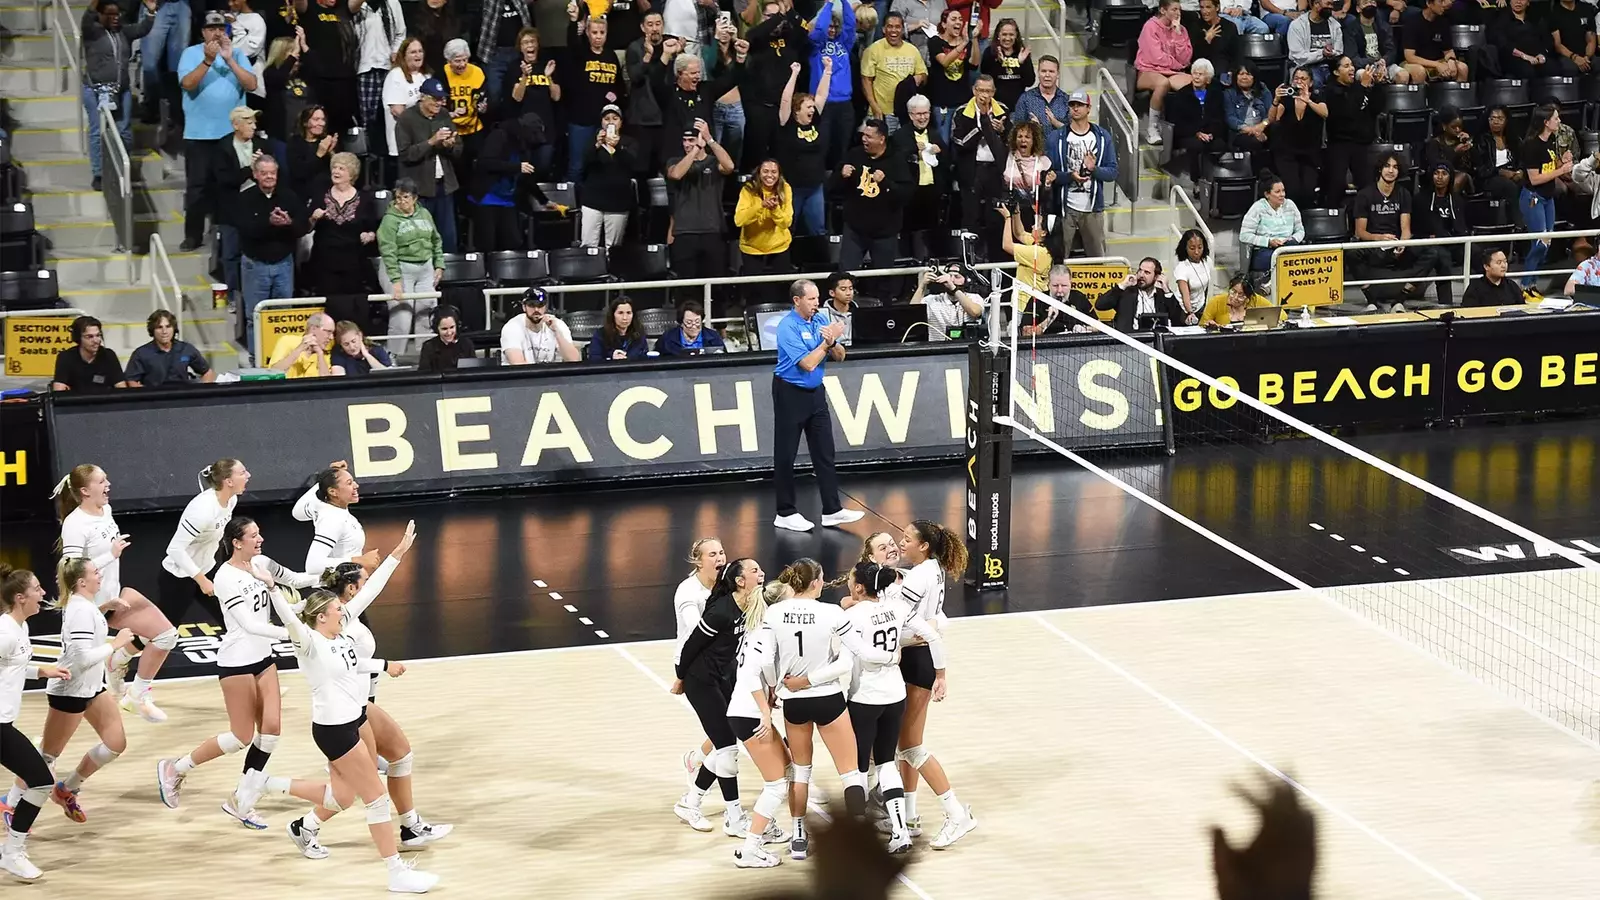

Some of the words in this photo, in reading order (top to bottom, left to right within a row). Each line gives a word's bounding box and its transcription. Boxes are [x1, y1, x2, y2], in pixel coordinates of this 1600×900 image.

[1371, 203, 1400, 212] BEACH
[1283, 258, 1321, 268] SECTION
[1323, 255, 1338, 263] 104
[1072, 271, 1106, 279] ECTION
[1108, 271, 1123, 279] 103
[1288, 268, 1315, 277] ROWS
[1317, 266, 1333, 274] A-U
[1292, 279, 1316, 287] Seats
[1318, 276, 1329, 284] 1-7
[13, 324, 60, 332] SECTION
[63, 324, 73, 332] 10
[267, 314, 311, 324] SECTION
[274, 325, 305, 334] ROWS
[1457, 357, 1523, 393] GO
[1540, 352, 1599, 388] BE
[1174, 375, 1241, 412] GO
[1257, 363, 1431, 406] BEACH
[347, 380, 760, 478] BEACH
[822, 356, 1163, 446] WINS!
[967, 399, 979, 540] BEACH
[991, 492, 999, 518] sports
[990, 518, 999, 551] imports
[984, 553, 1004, 579] LB
[253, 590, 268, 612] 20
[783, 612, 816, 625] MEYER
[870, 610, 897, 626] GLENN
[794, 630, 804, 657] 1
[341, 649, 357, 671] 19
